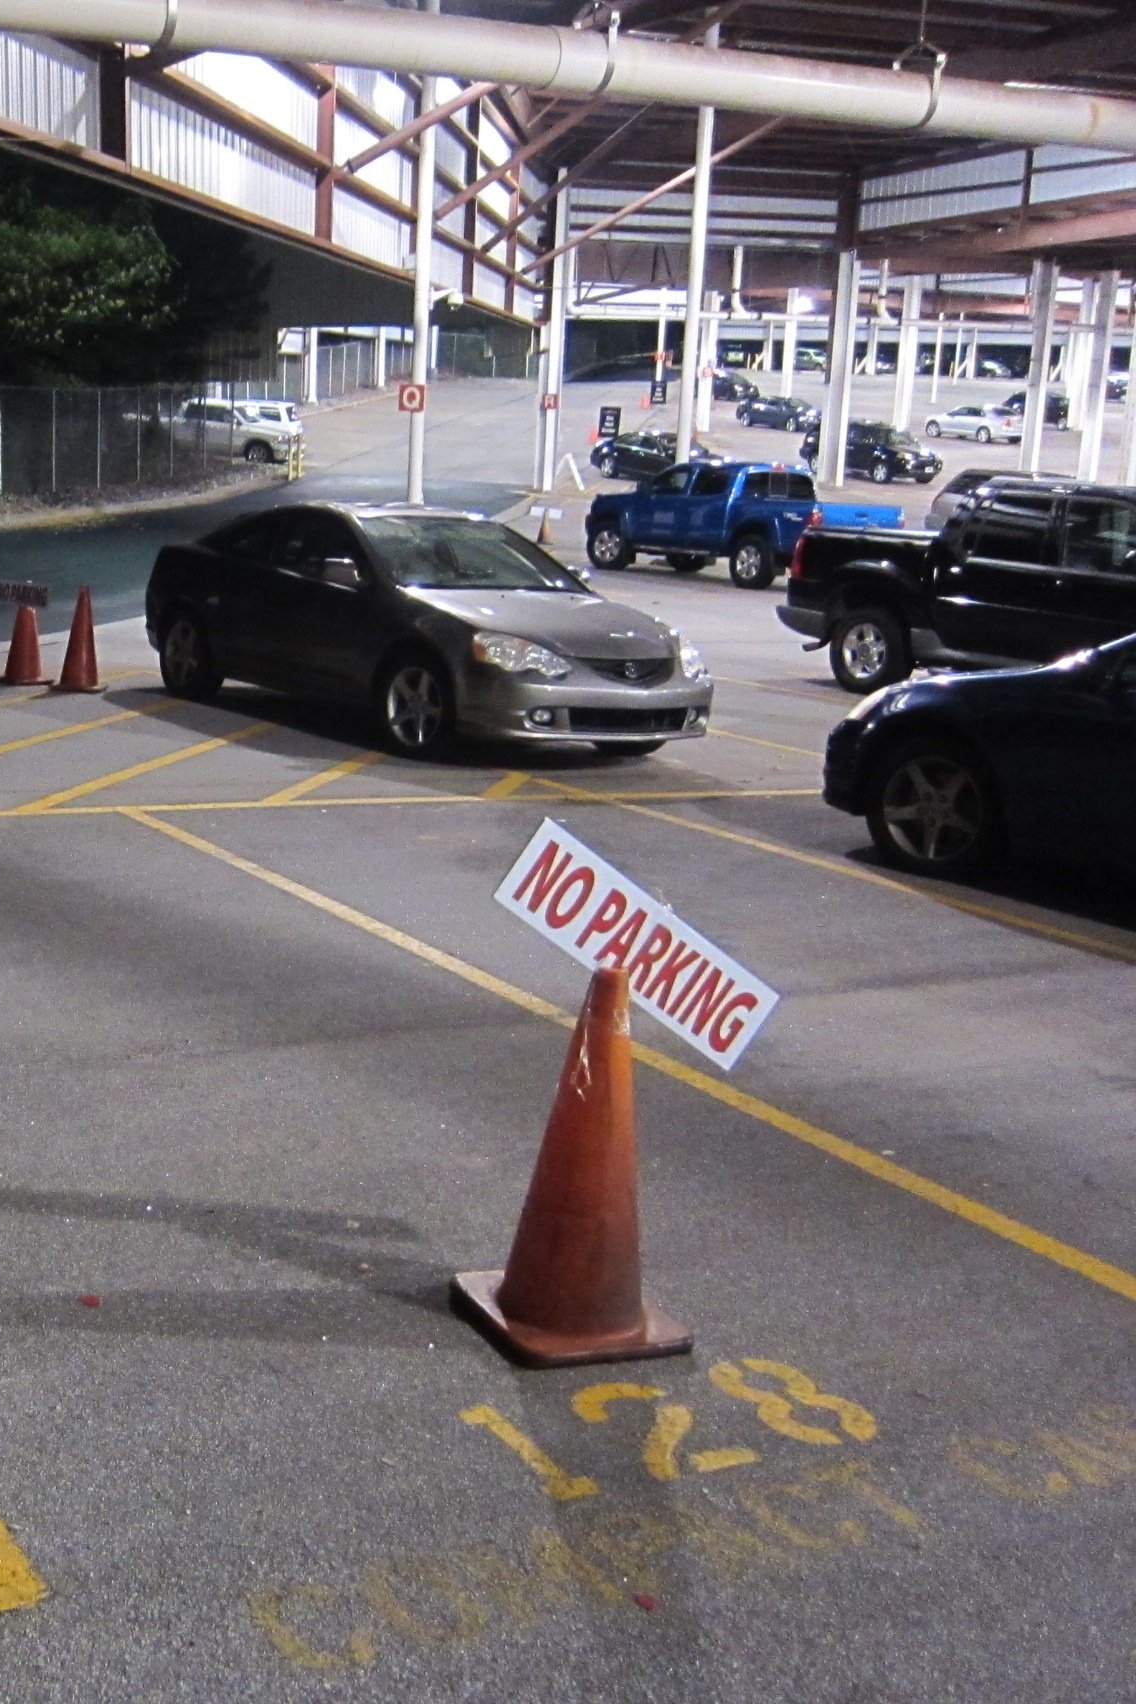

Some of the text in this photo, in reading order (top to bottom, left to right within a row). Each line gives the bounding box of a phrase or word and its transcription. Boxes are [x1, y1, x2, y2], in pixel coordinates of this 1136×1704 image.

[402, 388, 419, 409] Q
[512, 840, 759, 1054] NO PARKING
[458, 1356, 879, 1502] 128
